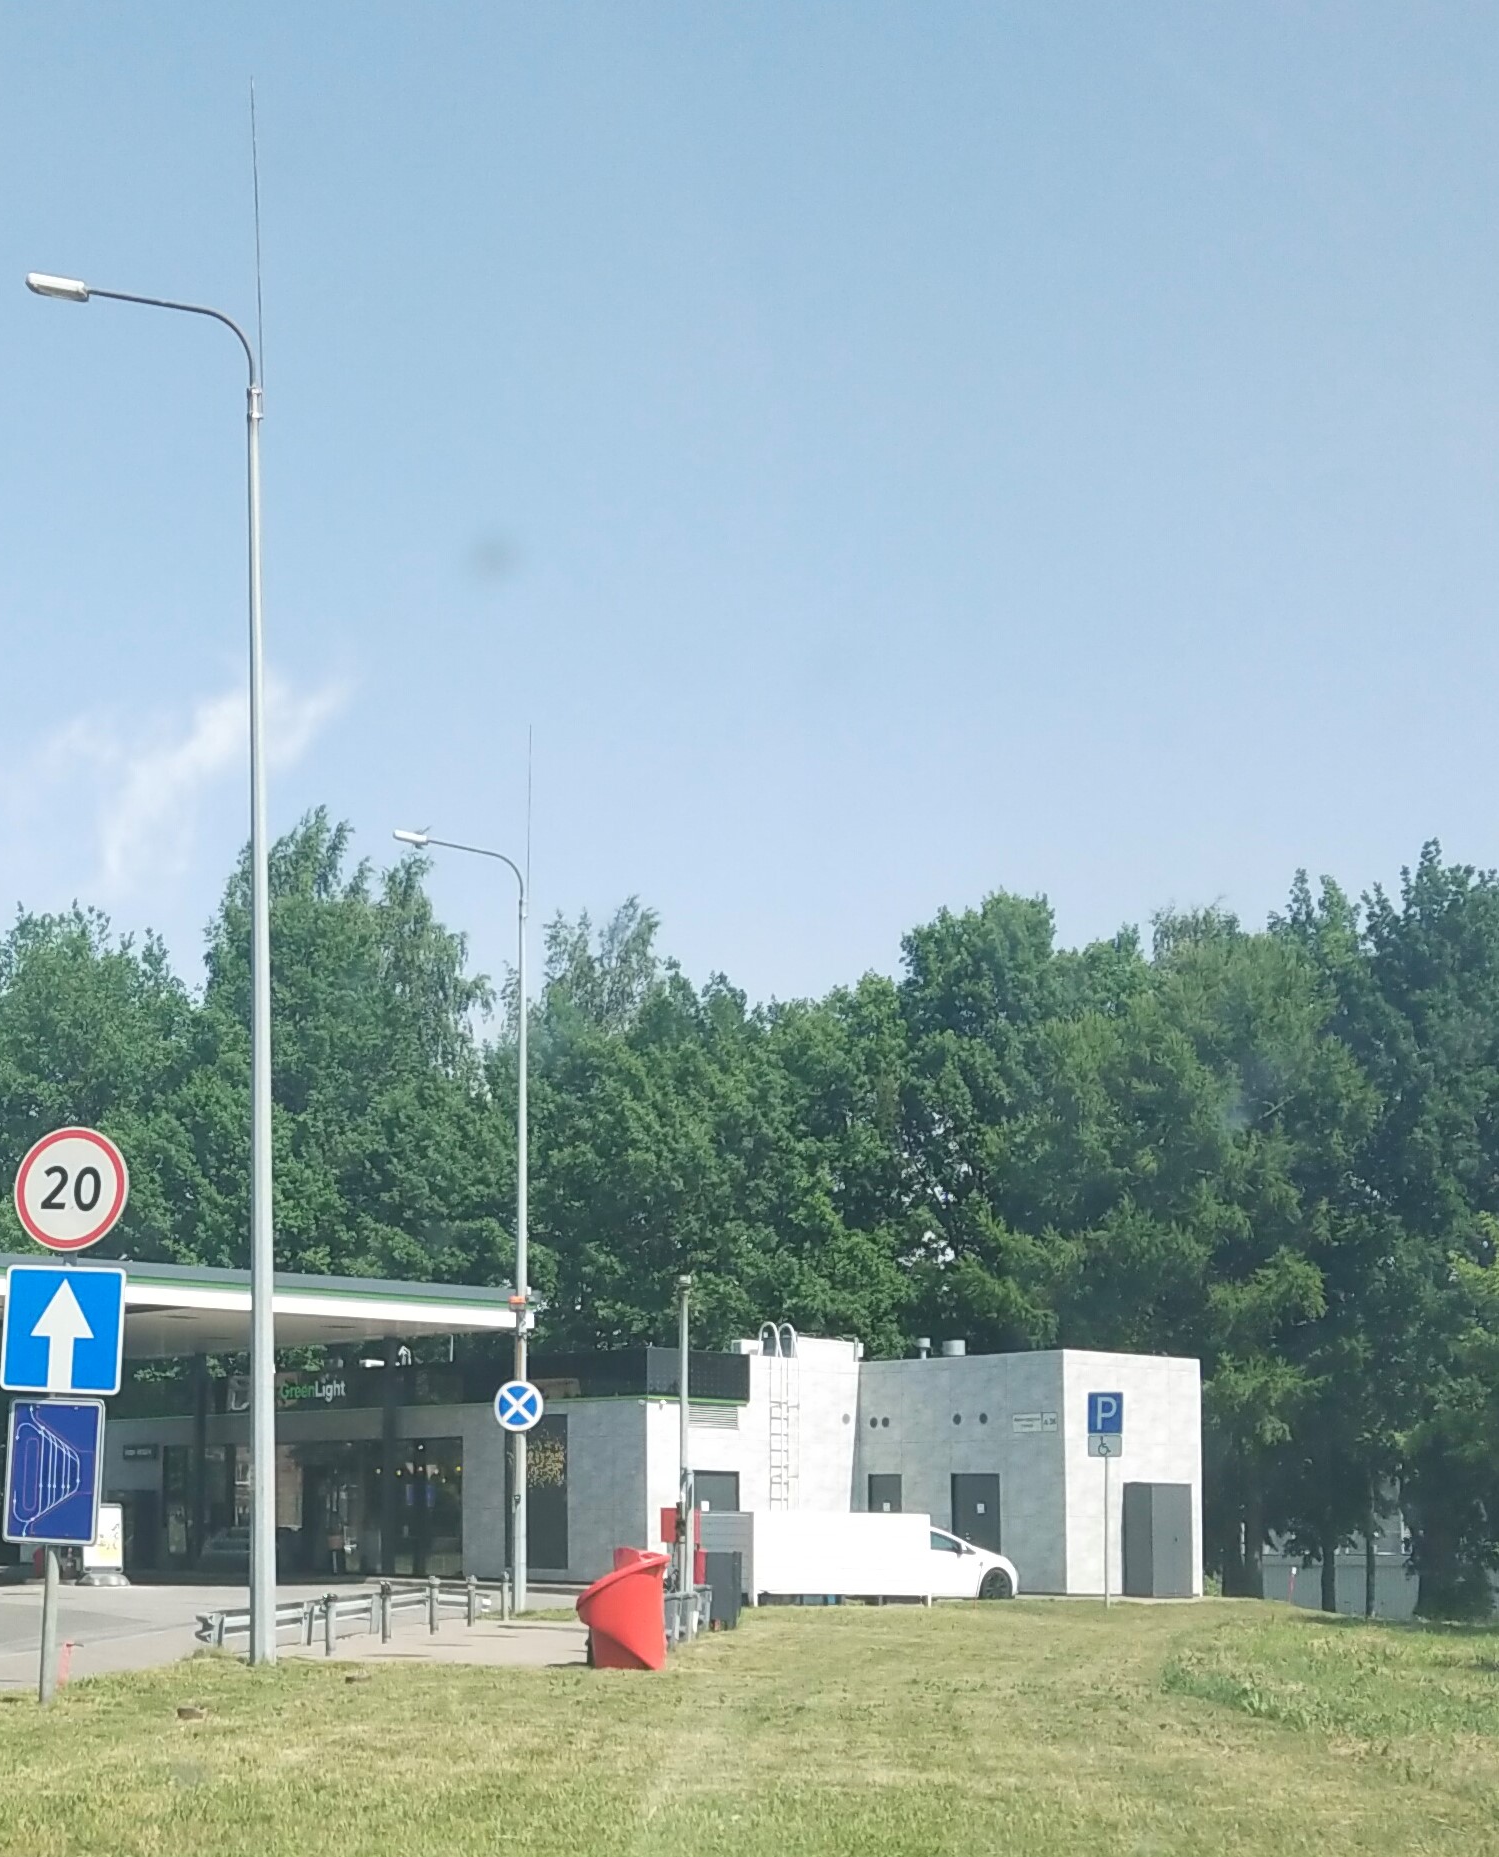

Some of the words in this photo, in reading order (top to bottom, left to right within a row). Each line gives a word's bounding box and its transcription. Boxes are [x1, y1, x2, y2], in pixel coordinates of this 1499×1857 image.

[40, 1165, 102, 1212] 20
[280, 1379, 346, 1403] GreenLight
[1096, 1395, 1118, 1431] P
